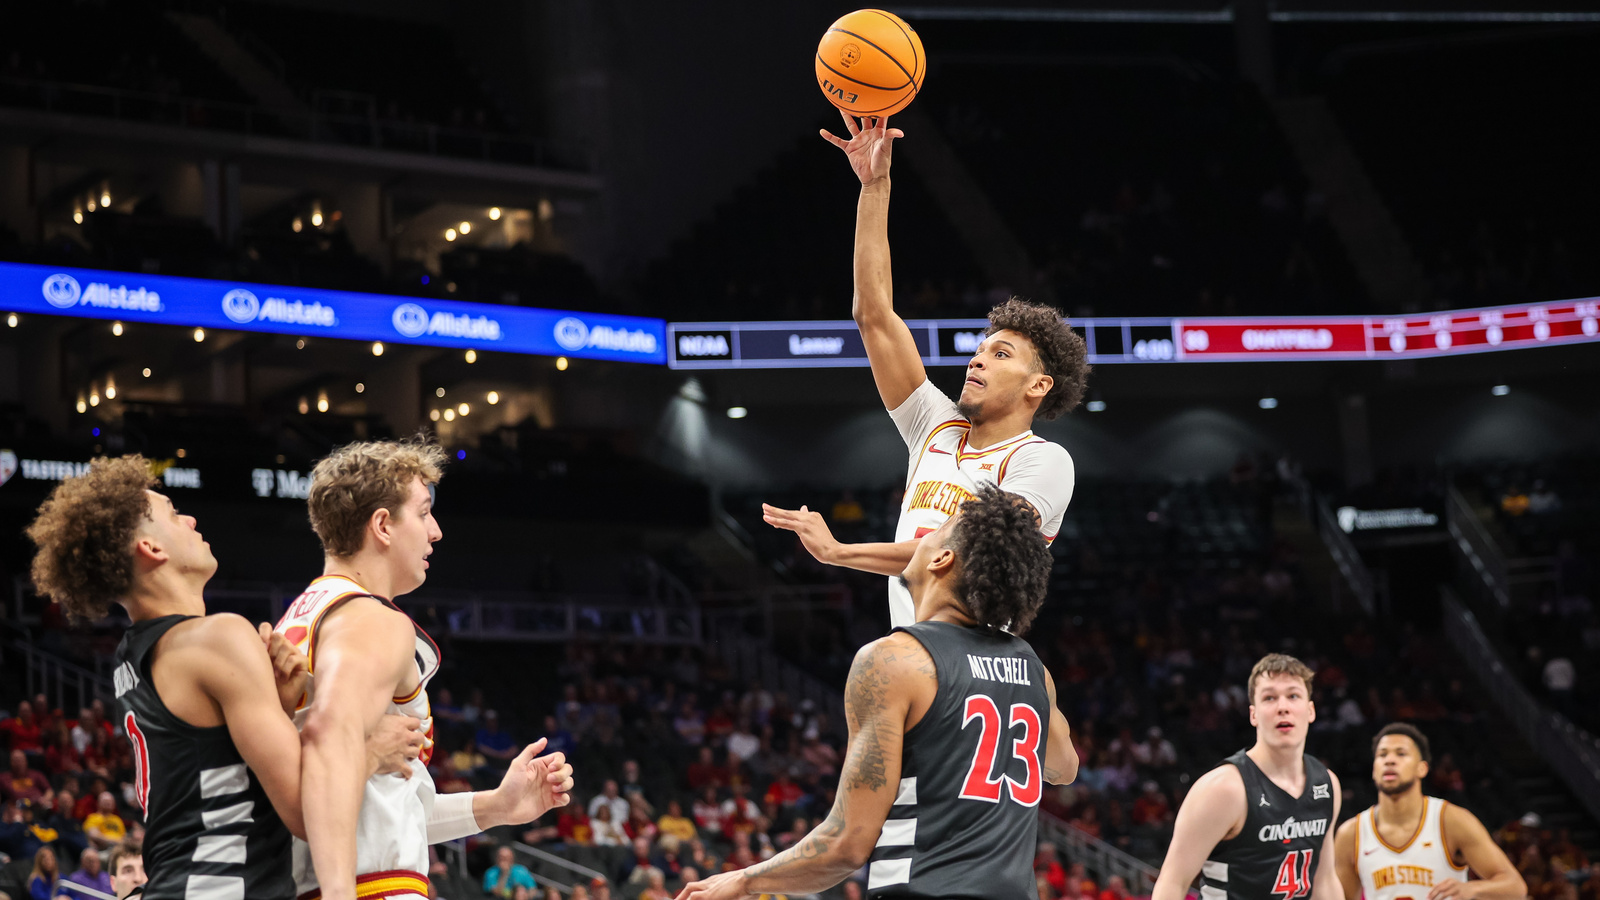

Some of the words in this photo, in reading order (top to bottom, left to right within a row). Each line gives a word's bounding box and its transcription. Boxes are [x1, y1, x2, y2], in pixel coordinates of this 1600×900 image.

[80, 282, 160, 313] Allstate
[258, 297, 335, 327] Allstate
[427, 311, 501, 341] Allstate
[586, 325, 657, 354] Allstate
[907, 481, 944, 513] IOWA
[933, 481, 982, 516] STAT
[967, 654, 1030, 686] MITCHELL
[958, 694, 1042, 807] 23
[1258, 816, 1327, 843] CINCINNATI
[1270, 849, 1313, 900] 41
[1397, 865, 1434, 887] STATE
